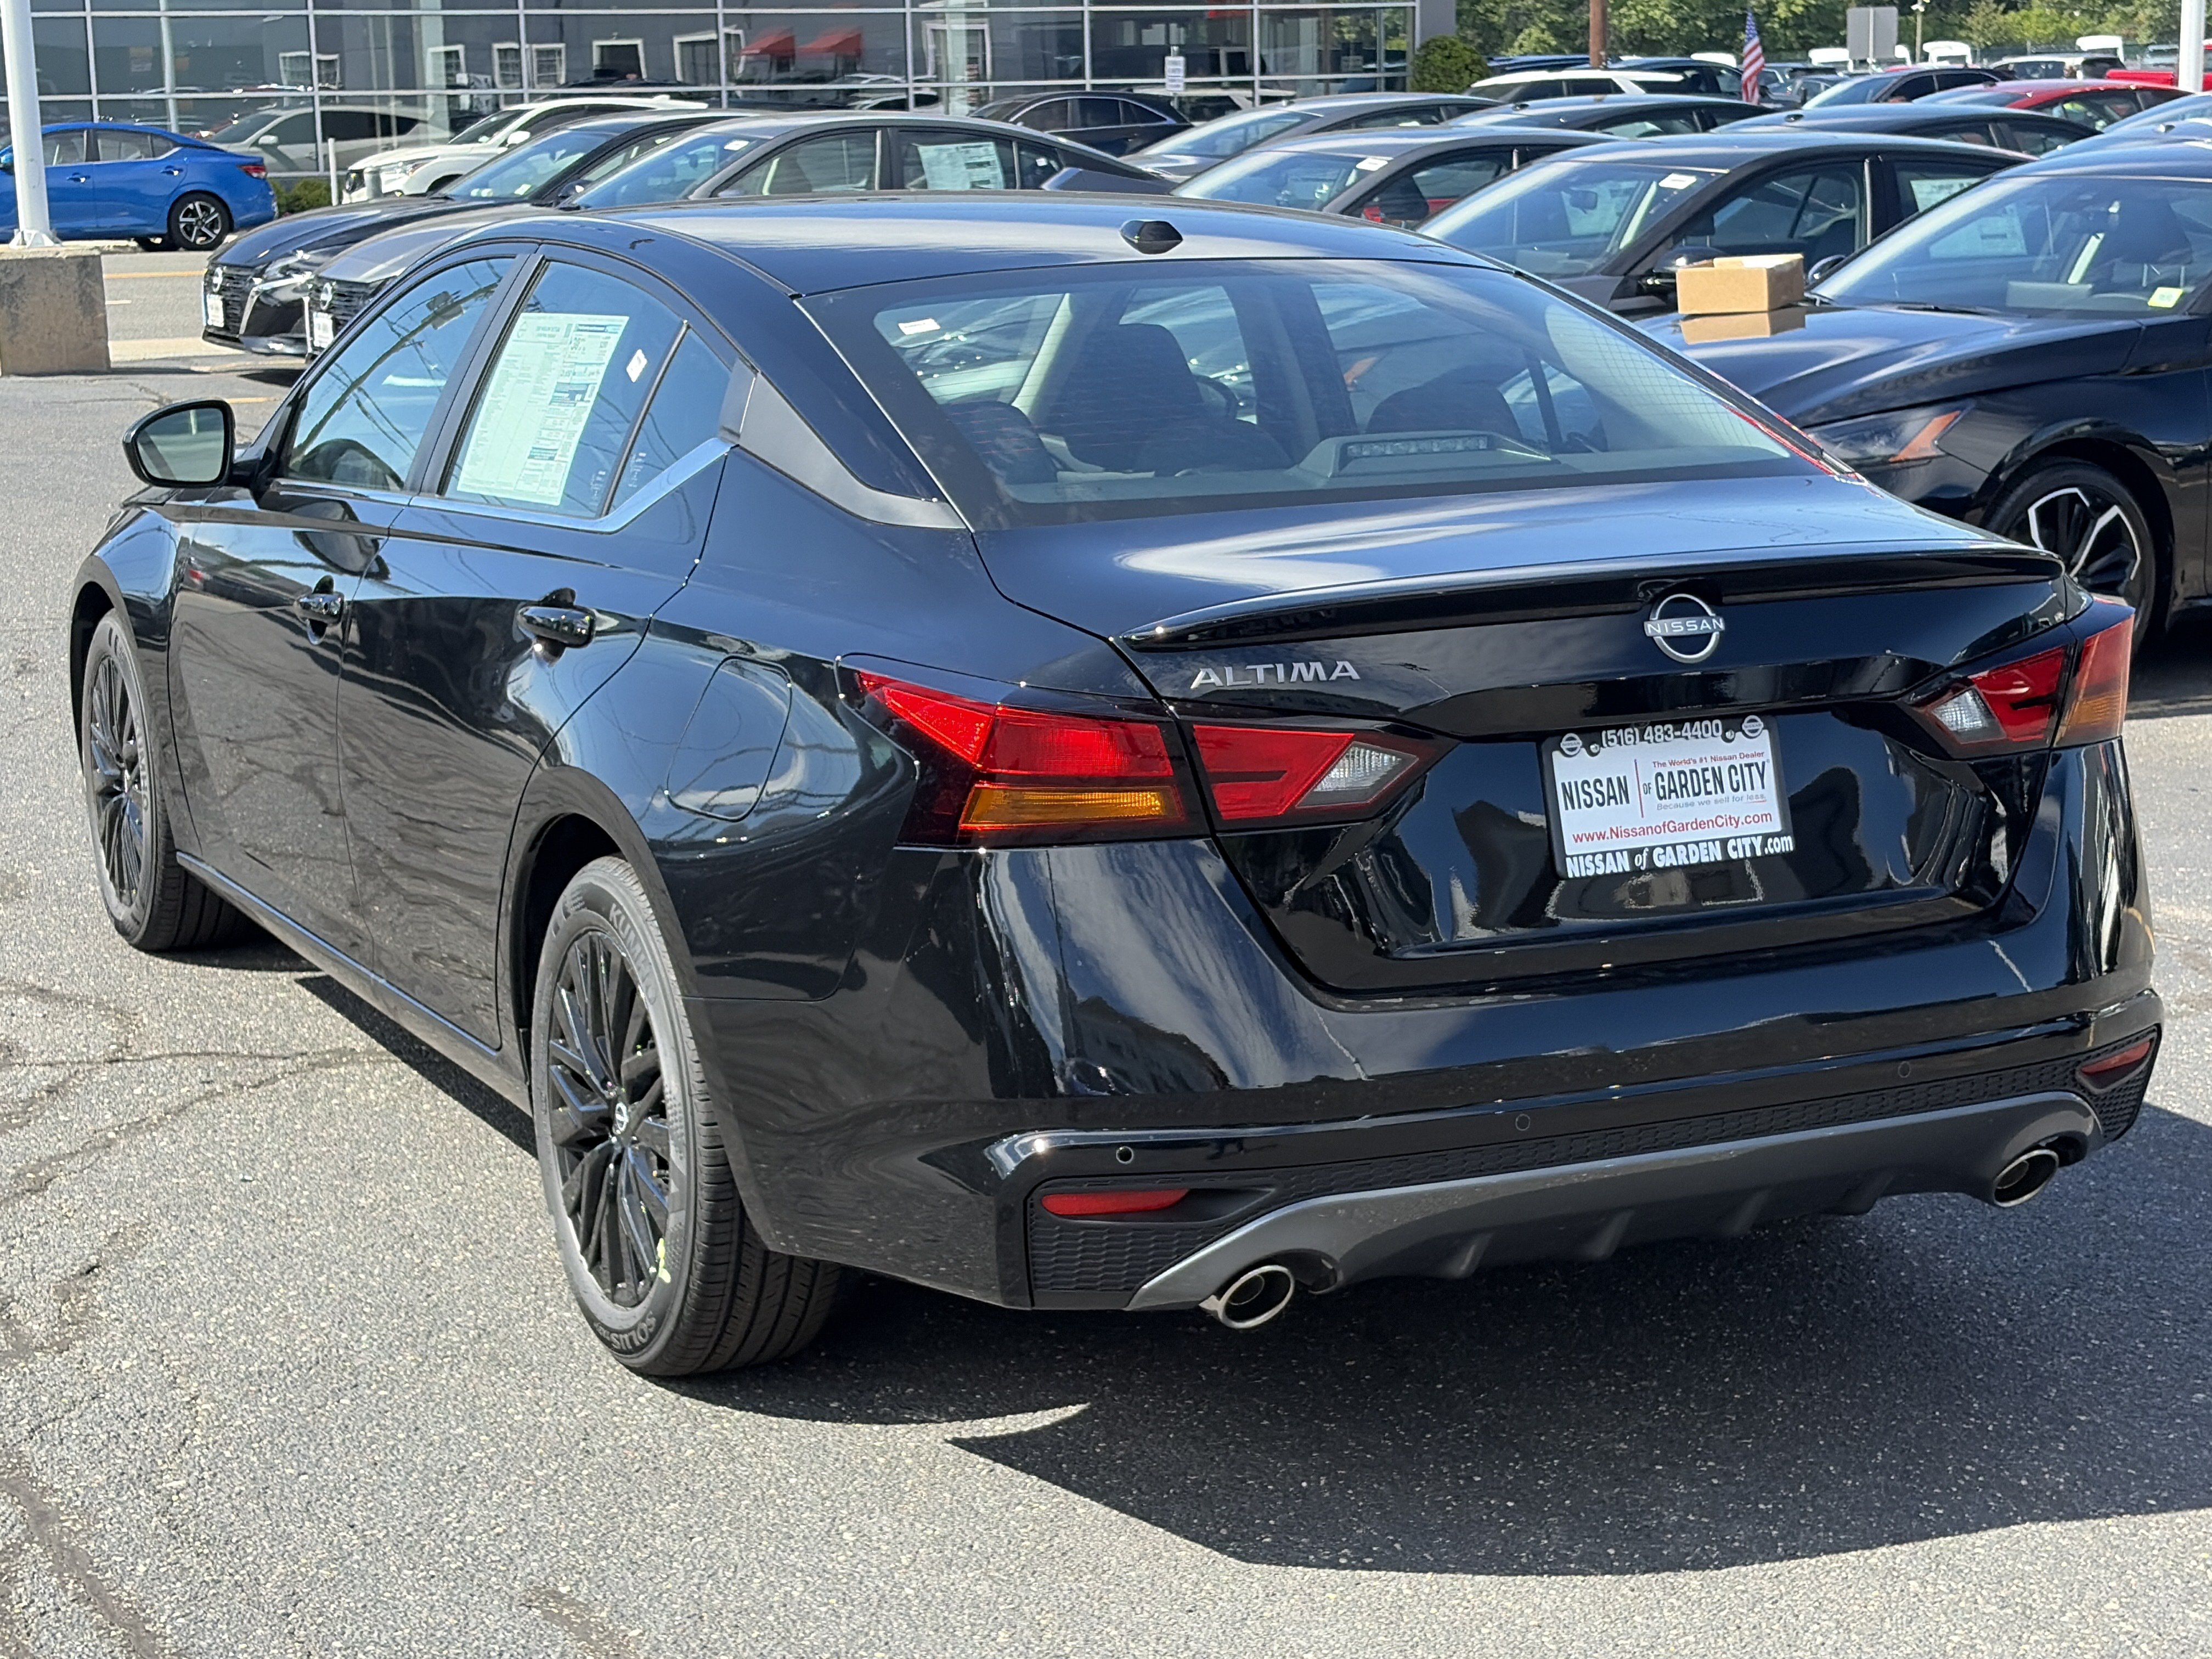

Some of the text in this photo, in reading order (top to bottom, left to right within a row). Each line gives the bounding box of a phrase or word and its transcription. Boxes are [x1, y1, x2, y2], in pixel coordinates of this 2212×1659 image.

[1646, 618, 1724, 634] NISSAN
[1190, 660, 1361, 690] ALTIMA
[1601, 719, 1723, 748] (516) 483-4400
[1668, 758, 1697, 767] World's
[1710, 754, 1737, 763] Nissan
[1739, 751, 1765, 759] Dealer
[1561, 761, 1766, 811] NISSAN OF GARDEN CITY
[1657, 802, 1695, 811] Because
[1572, 812, 1773, 843] www.NissanofGardenCity.com
[1566, 851, 1631, 878] NISSAN
[1634, 848, 1649, 871] of
[1653, 840, 1722, 868] GARDEN
[610, 1310, 657, 1350] SOLUS
